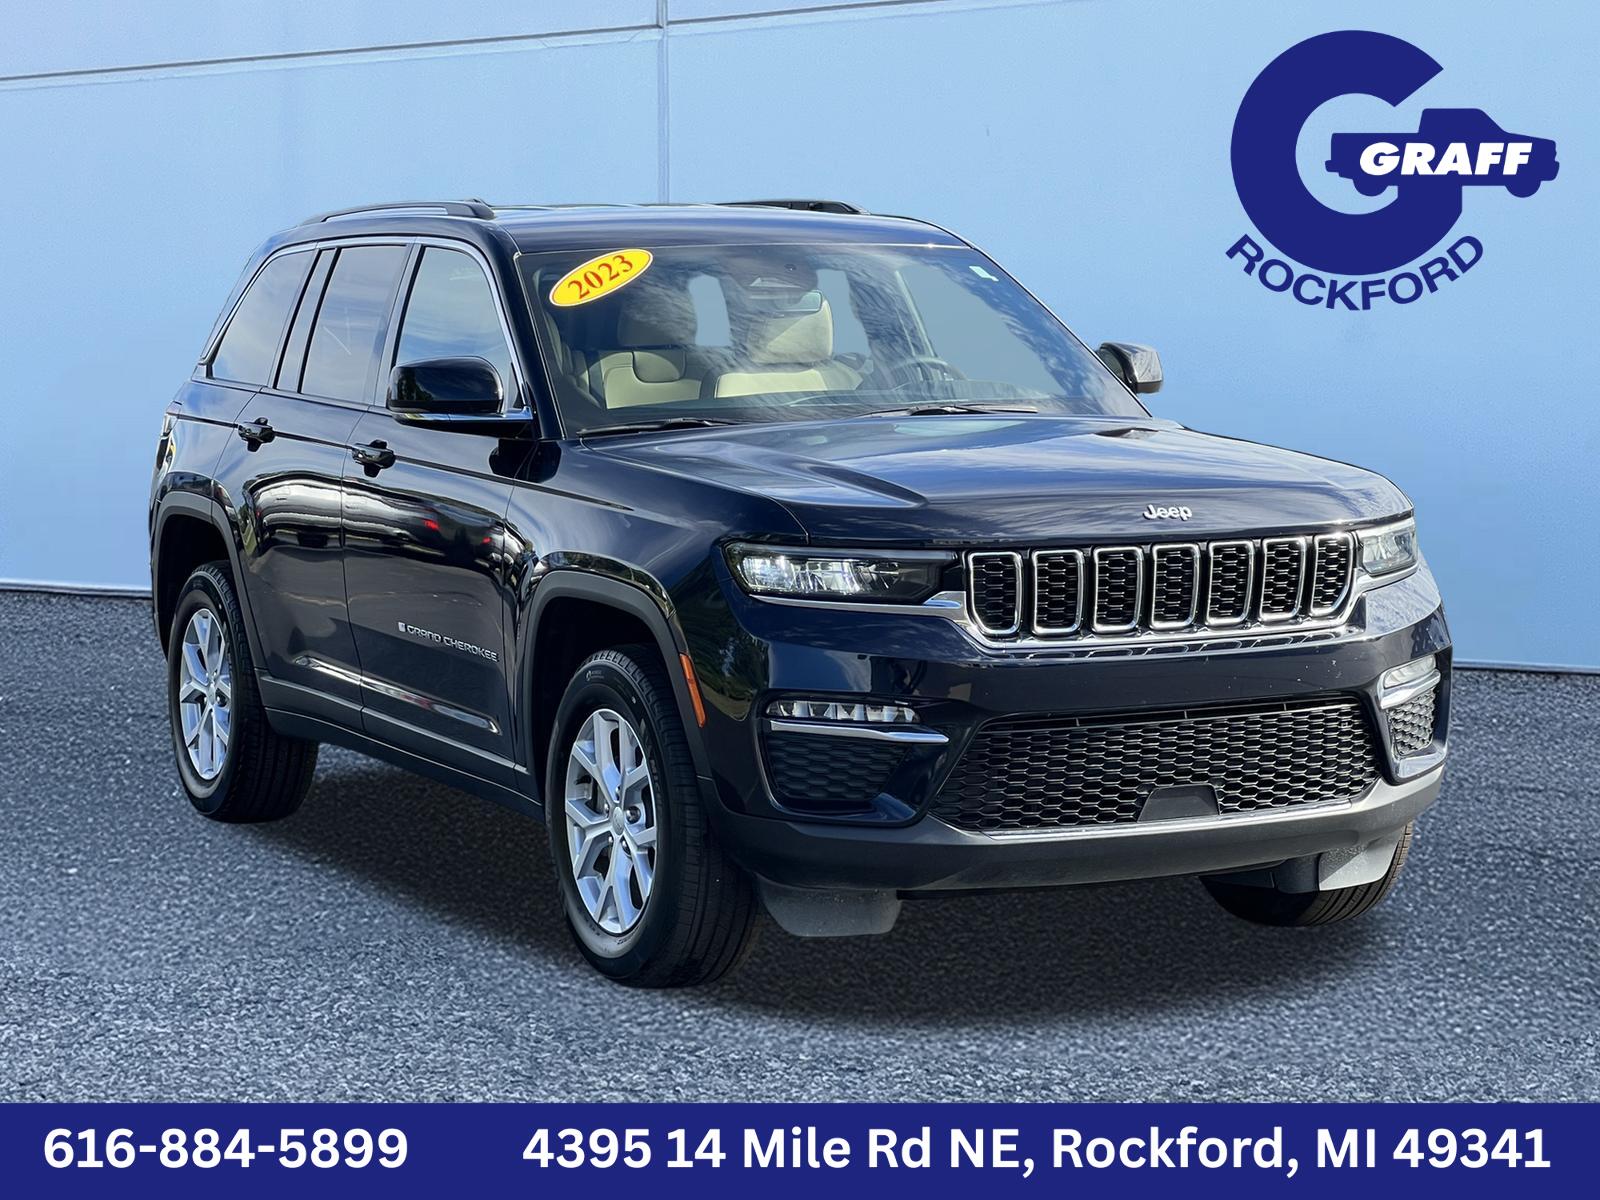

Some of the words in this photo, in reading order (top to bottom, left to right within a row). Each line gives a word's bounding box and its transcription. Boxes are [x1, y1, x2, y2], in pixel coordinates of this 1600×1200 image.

[567, 255, 633, 300] 2023
[1143, 504, 1192, 521] Jeep
[407, 625, 442, 643] GRAND
[443, 636, 498, 662] CHEROKEE
